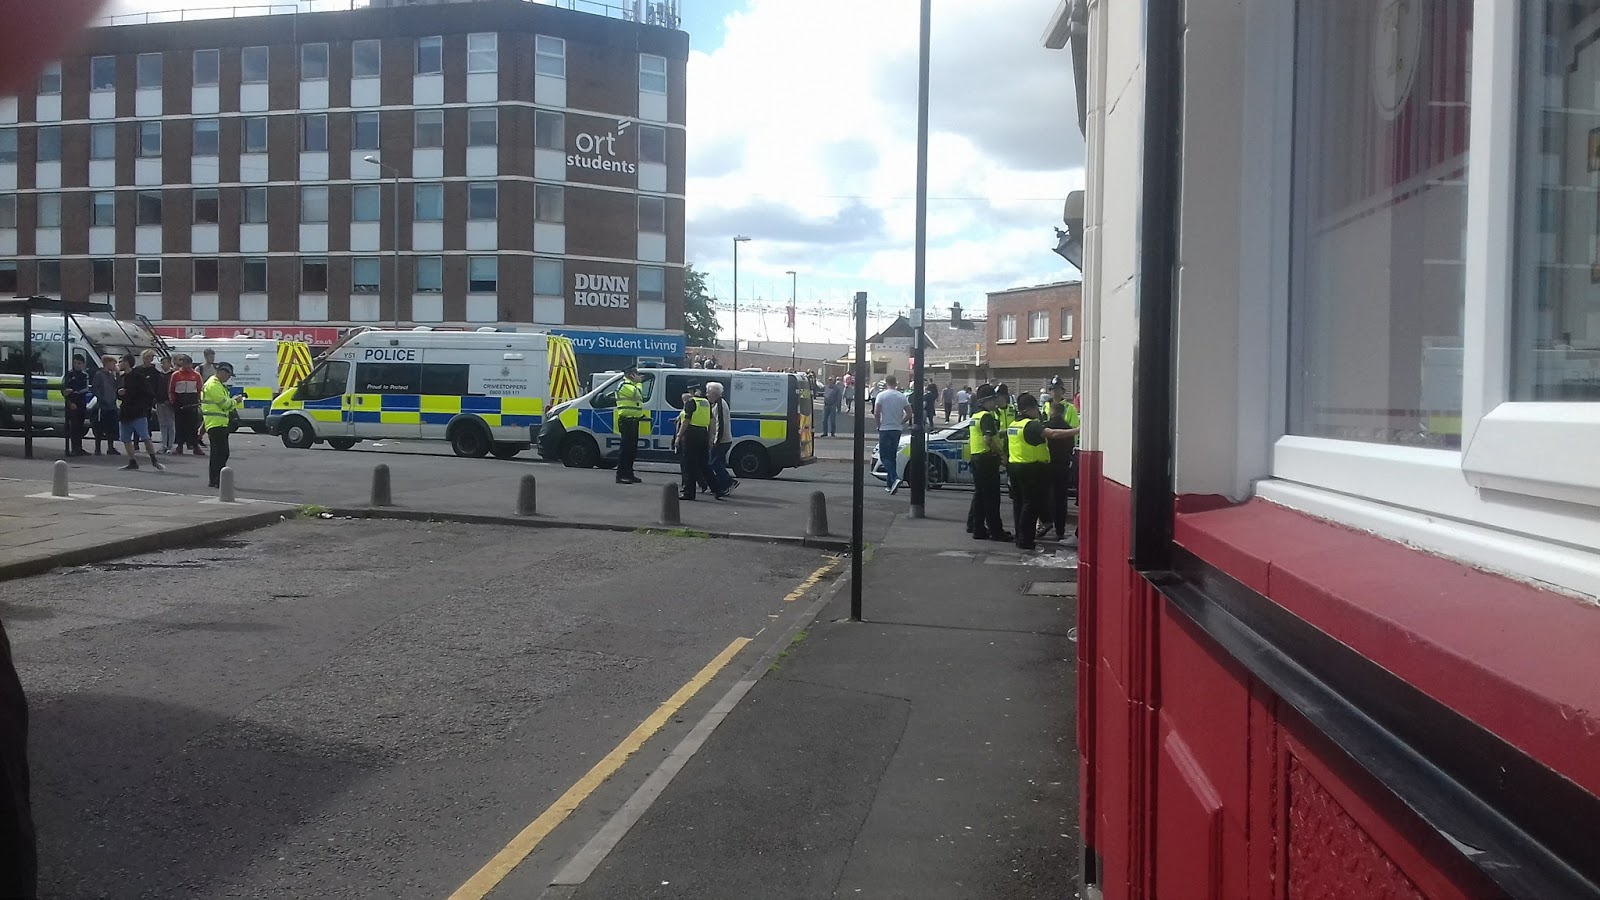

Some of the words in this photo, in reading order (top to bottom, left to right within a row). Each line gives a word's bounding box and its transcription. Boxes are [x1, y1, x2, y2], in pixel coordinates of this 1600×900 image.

[566, 154, 636, 174] students
[574, 273, 630, 293] DUNN
[574, 291, 630, 309] HOUSE
[598, 336, 642, 350] Student
[644, 338, 678, 353] Living
[364, 349, 416, 361] POLICE
